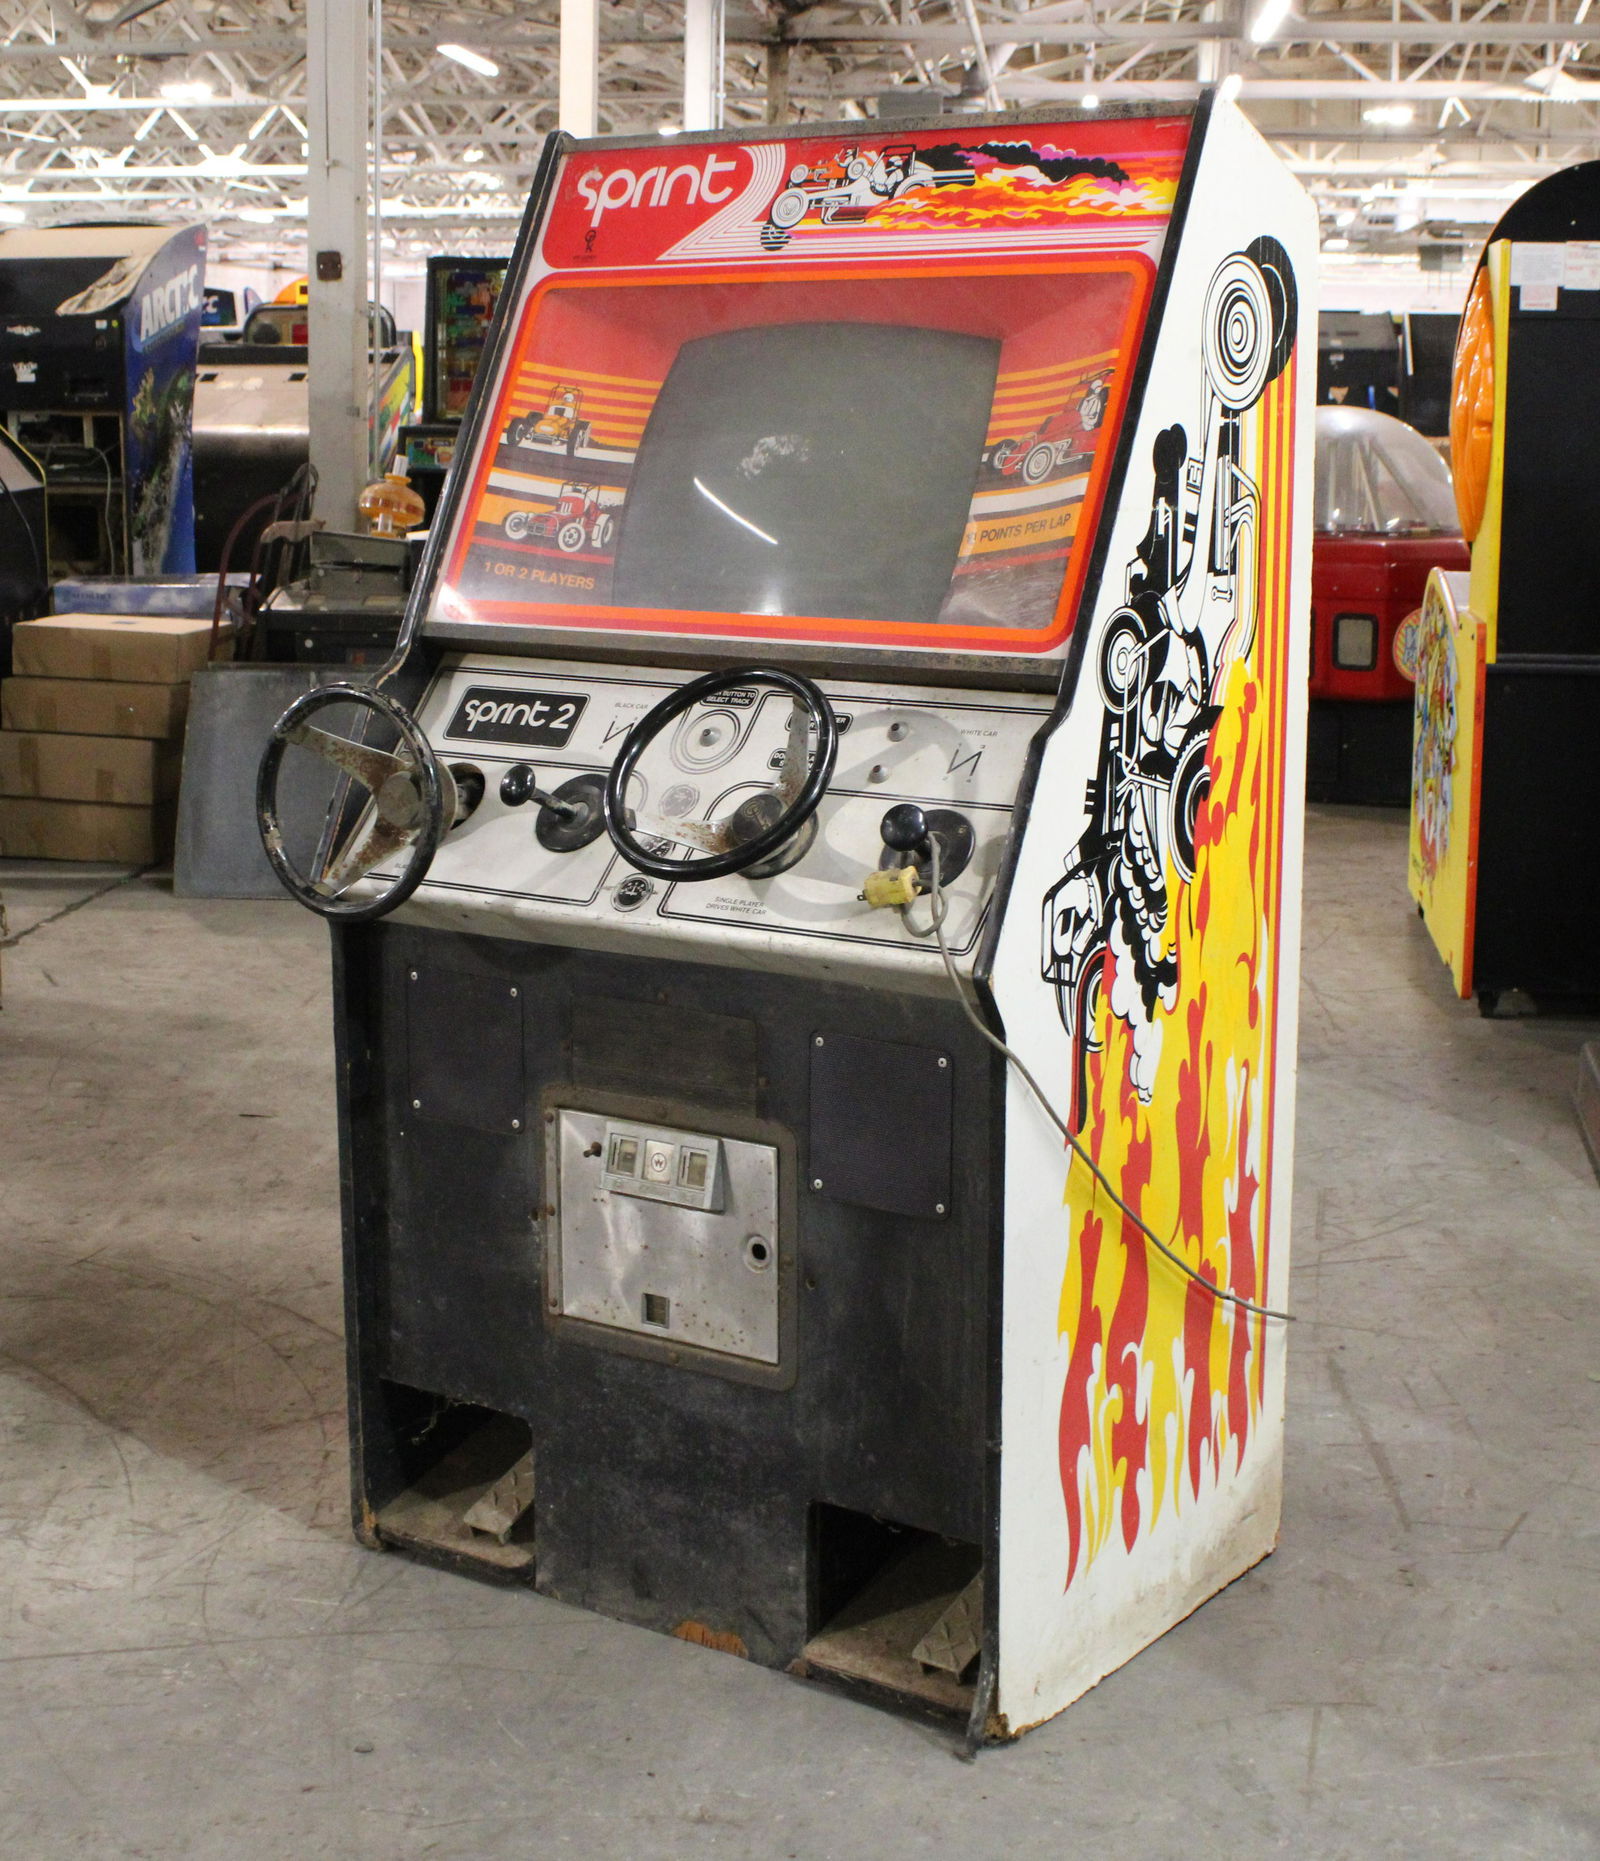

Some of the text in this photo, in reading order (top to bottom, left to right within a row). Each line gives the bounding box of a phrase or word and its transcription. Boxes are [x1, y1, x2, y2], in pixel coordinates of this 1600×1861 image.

[577, 154, 737, 228] sprint
[980, 525, 1022, 542] POINTS
[1024, 520, 1047, 536] PER
[1050, 513, 1072, 529] LAP
[484, 561, 596, 591] 1 OR 2 PLAYERS
[705, 695, 728, 703] SELECT
[464, 699, 576, 732] sprint 2
[960, 728, 982, 737] WHITE
[715, 896, 765, 907] SINGLE PLAYER
[730, 905, 752, 914] WHITE
